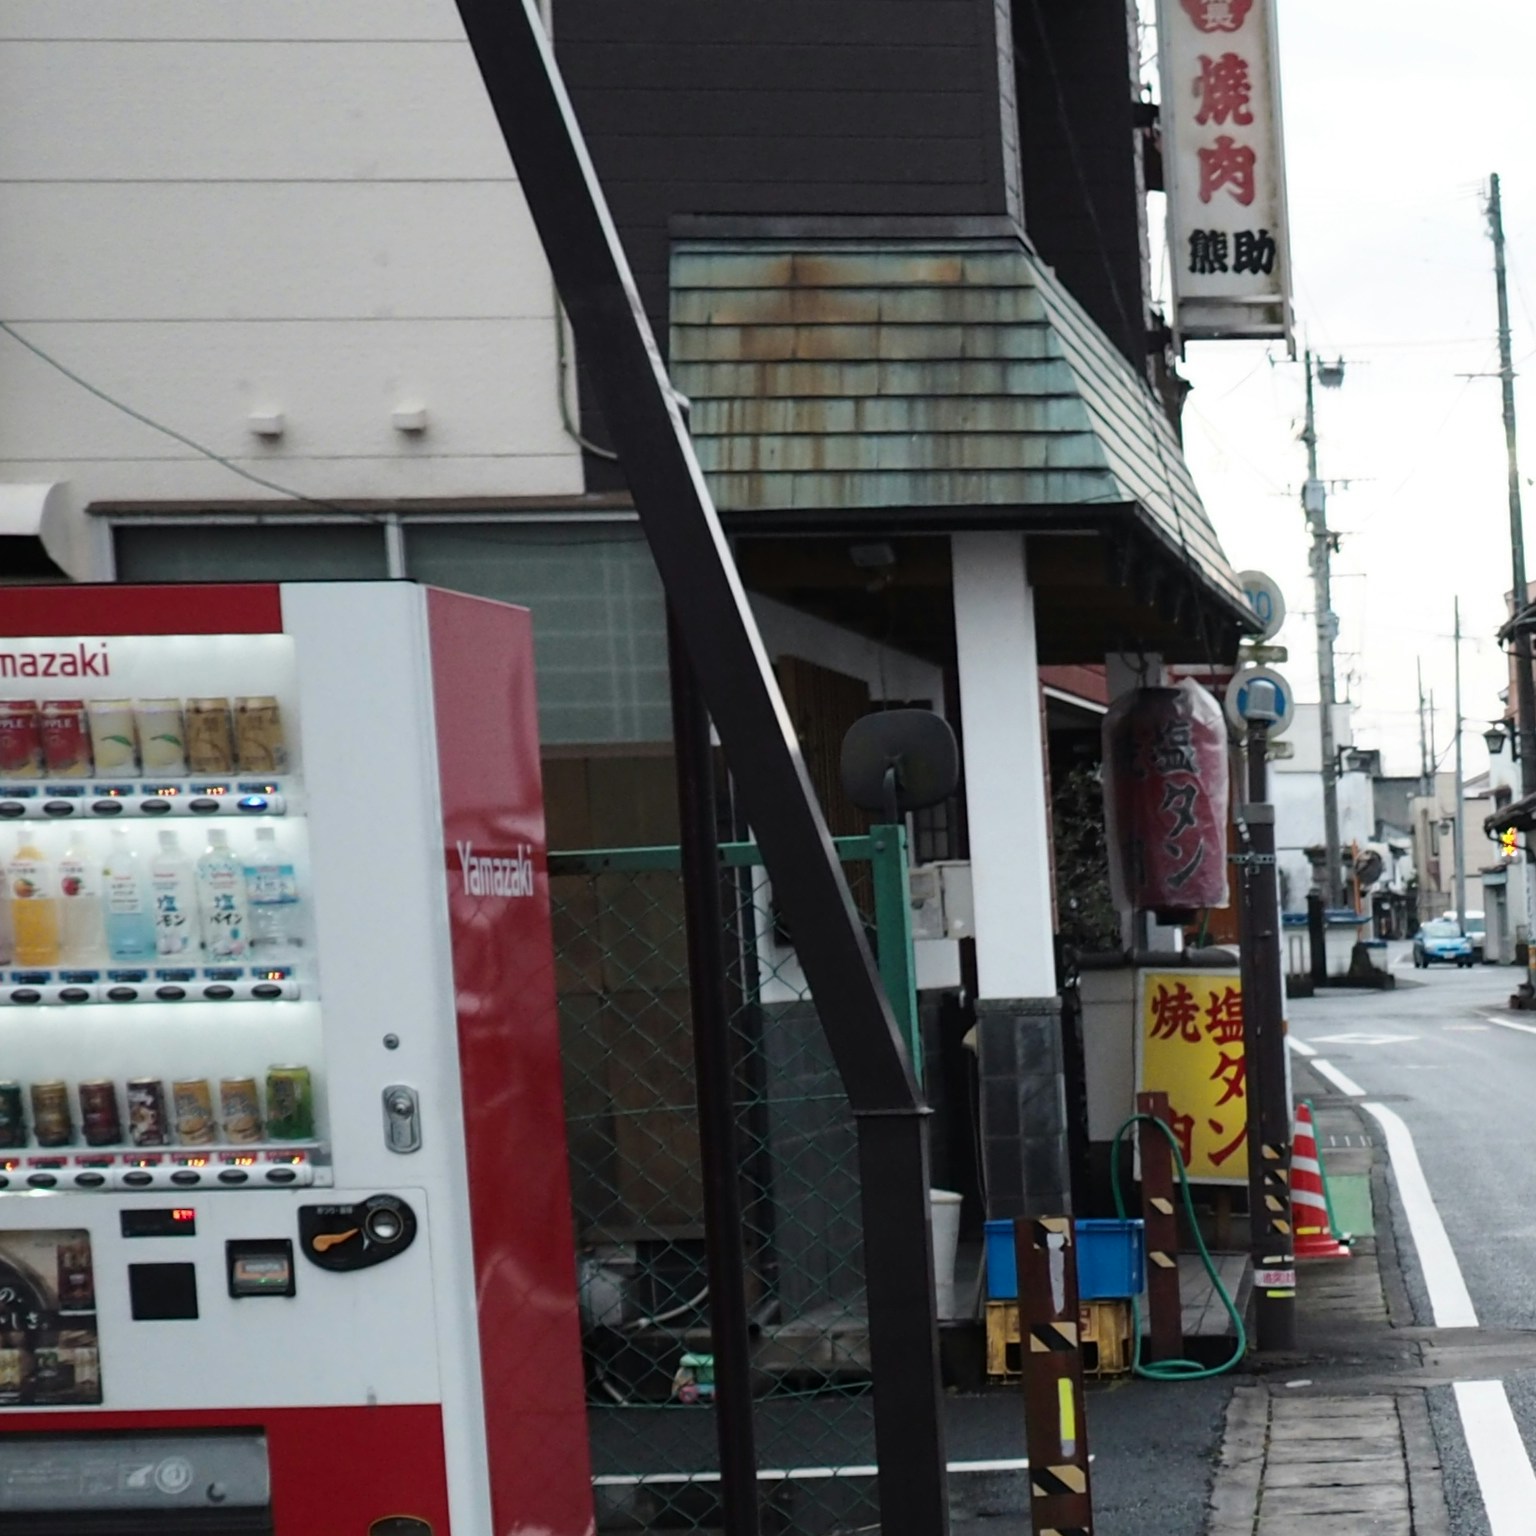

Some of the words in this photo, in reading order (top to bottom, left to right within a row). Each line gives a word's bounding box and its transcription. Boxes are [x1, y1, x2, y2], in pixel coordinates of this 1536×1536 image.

[1191, 52, 1256, 206] 焼肉
[1187, 228, 1276, 275] 熊助
[456, 840, 534, 897] Yamazaki
